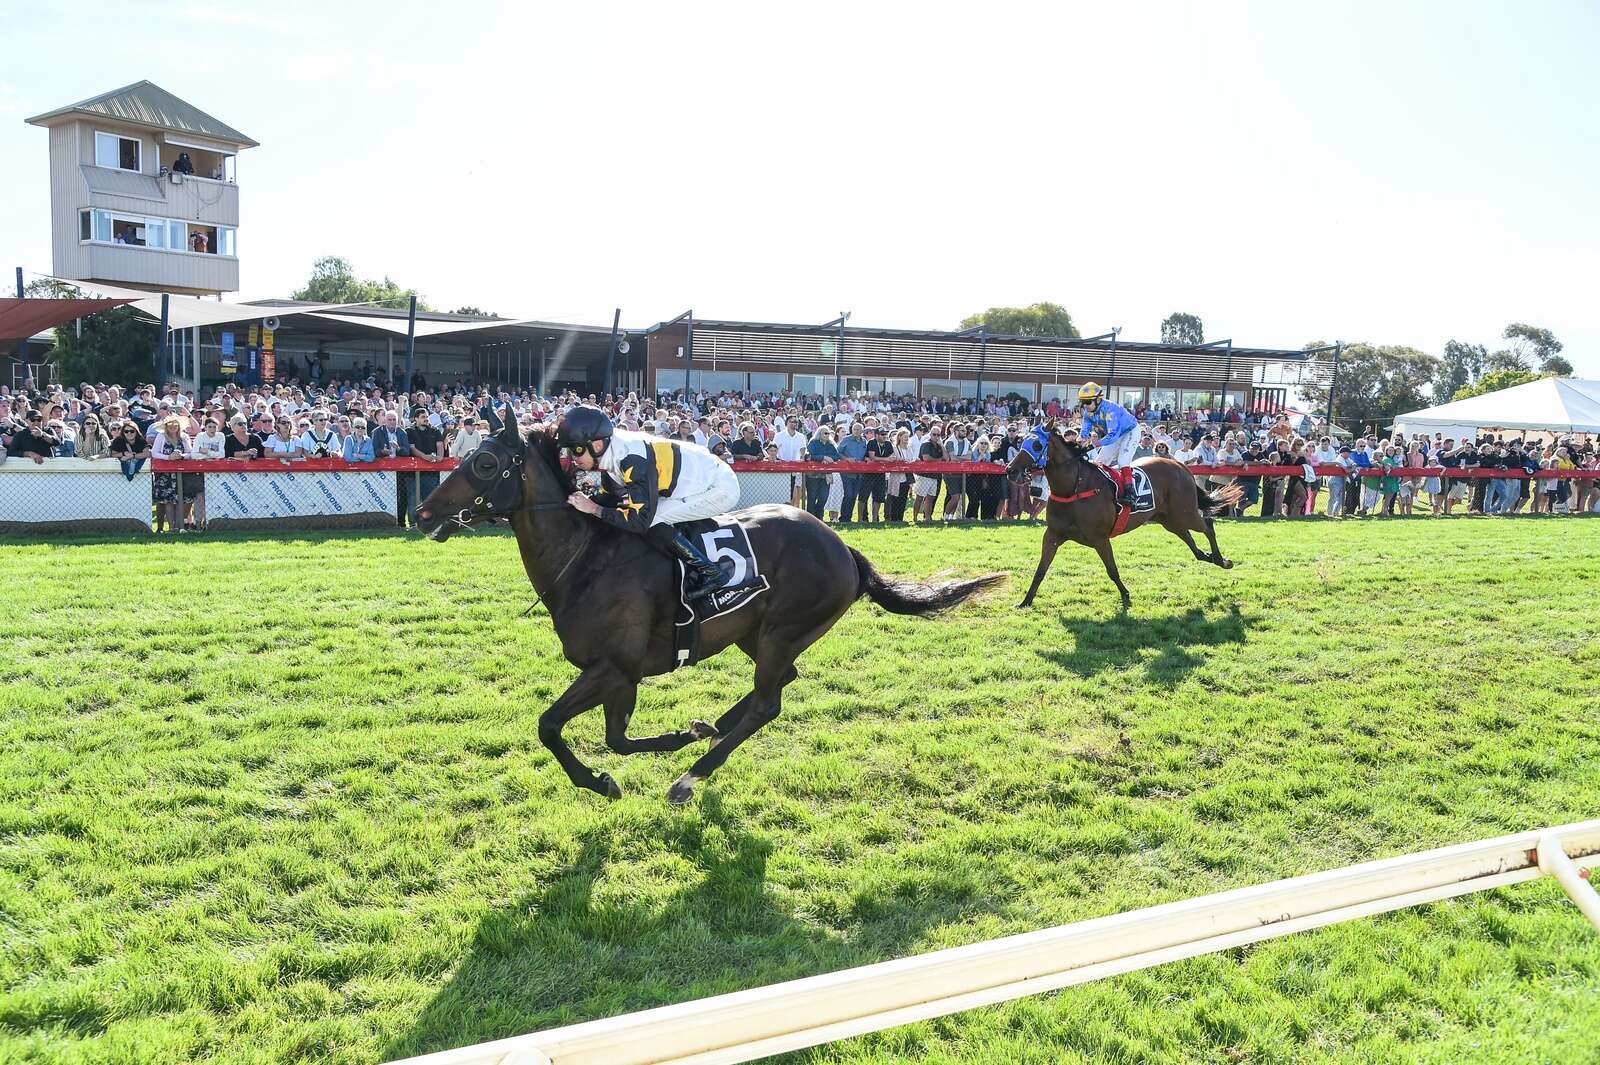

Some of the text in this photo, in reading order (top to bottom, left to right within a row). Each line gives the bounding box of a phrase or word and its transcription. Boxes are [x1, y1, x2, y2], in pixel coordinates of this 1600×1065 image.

[220, 481, 249, 514] PROBOND
[269, 480, 296, 513] PROBOND
[316, 479, 343, 512] PROBOND
[361, 479, 388, 511] PROBOND
[1132, 469, 1152, 496] 2
[701, 528, 747, 587] 5
